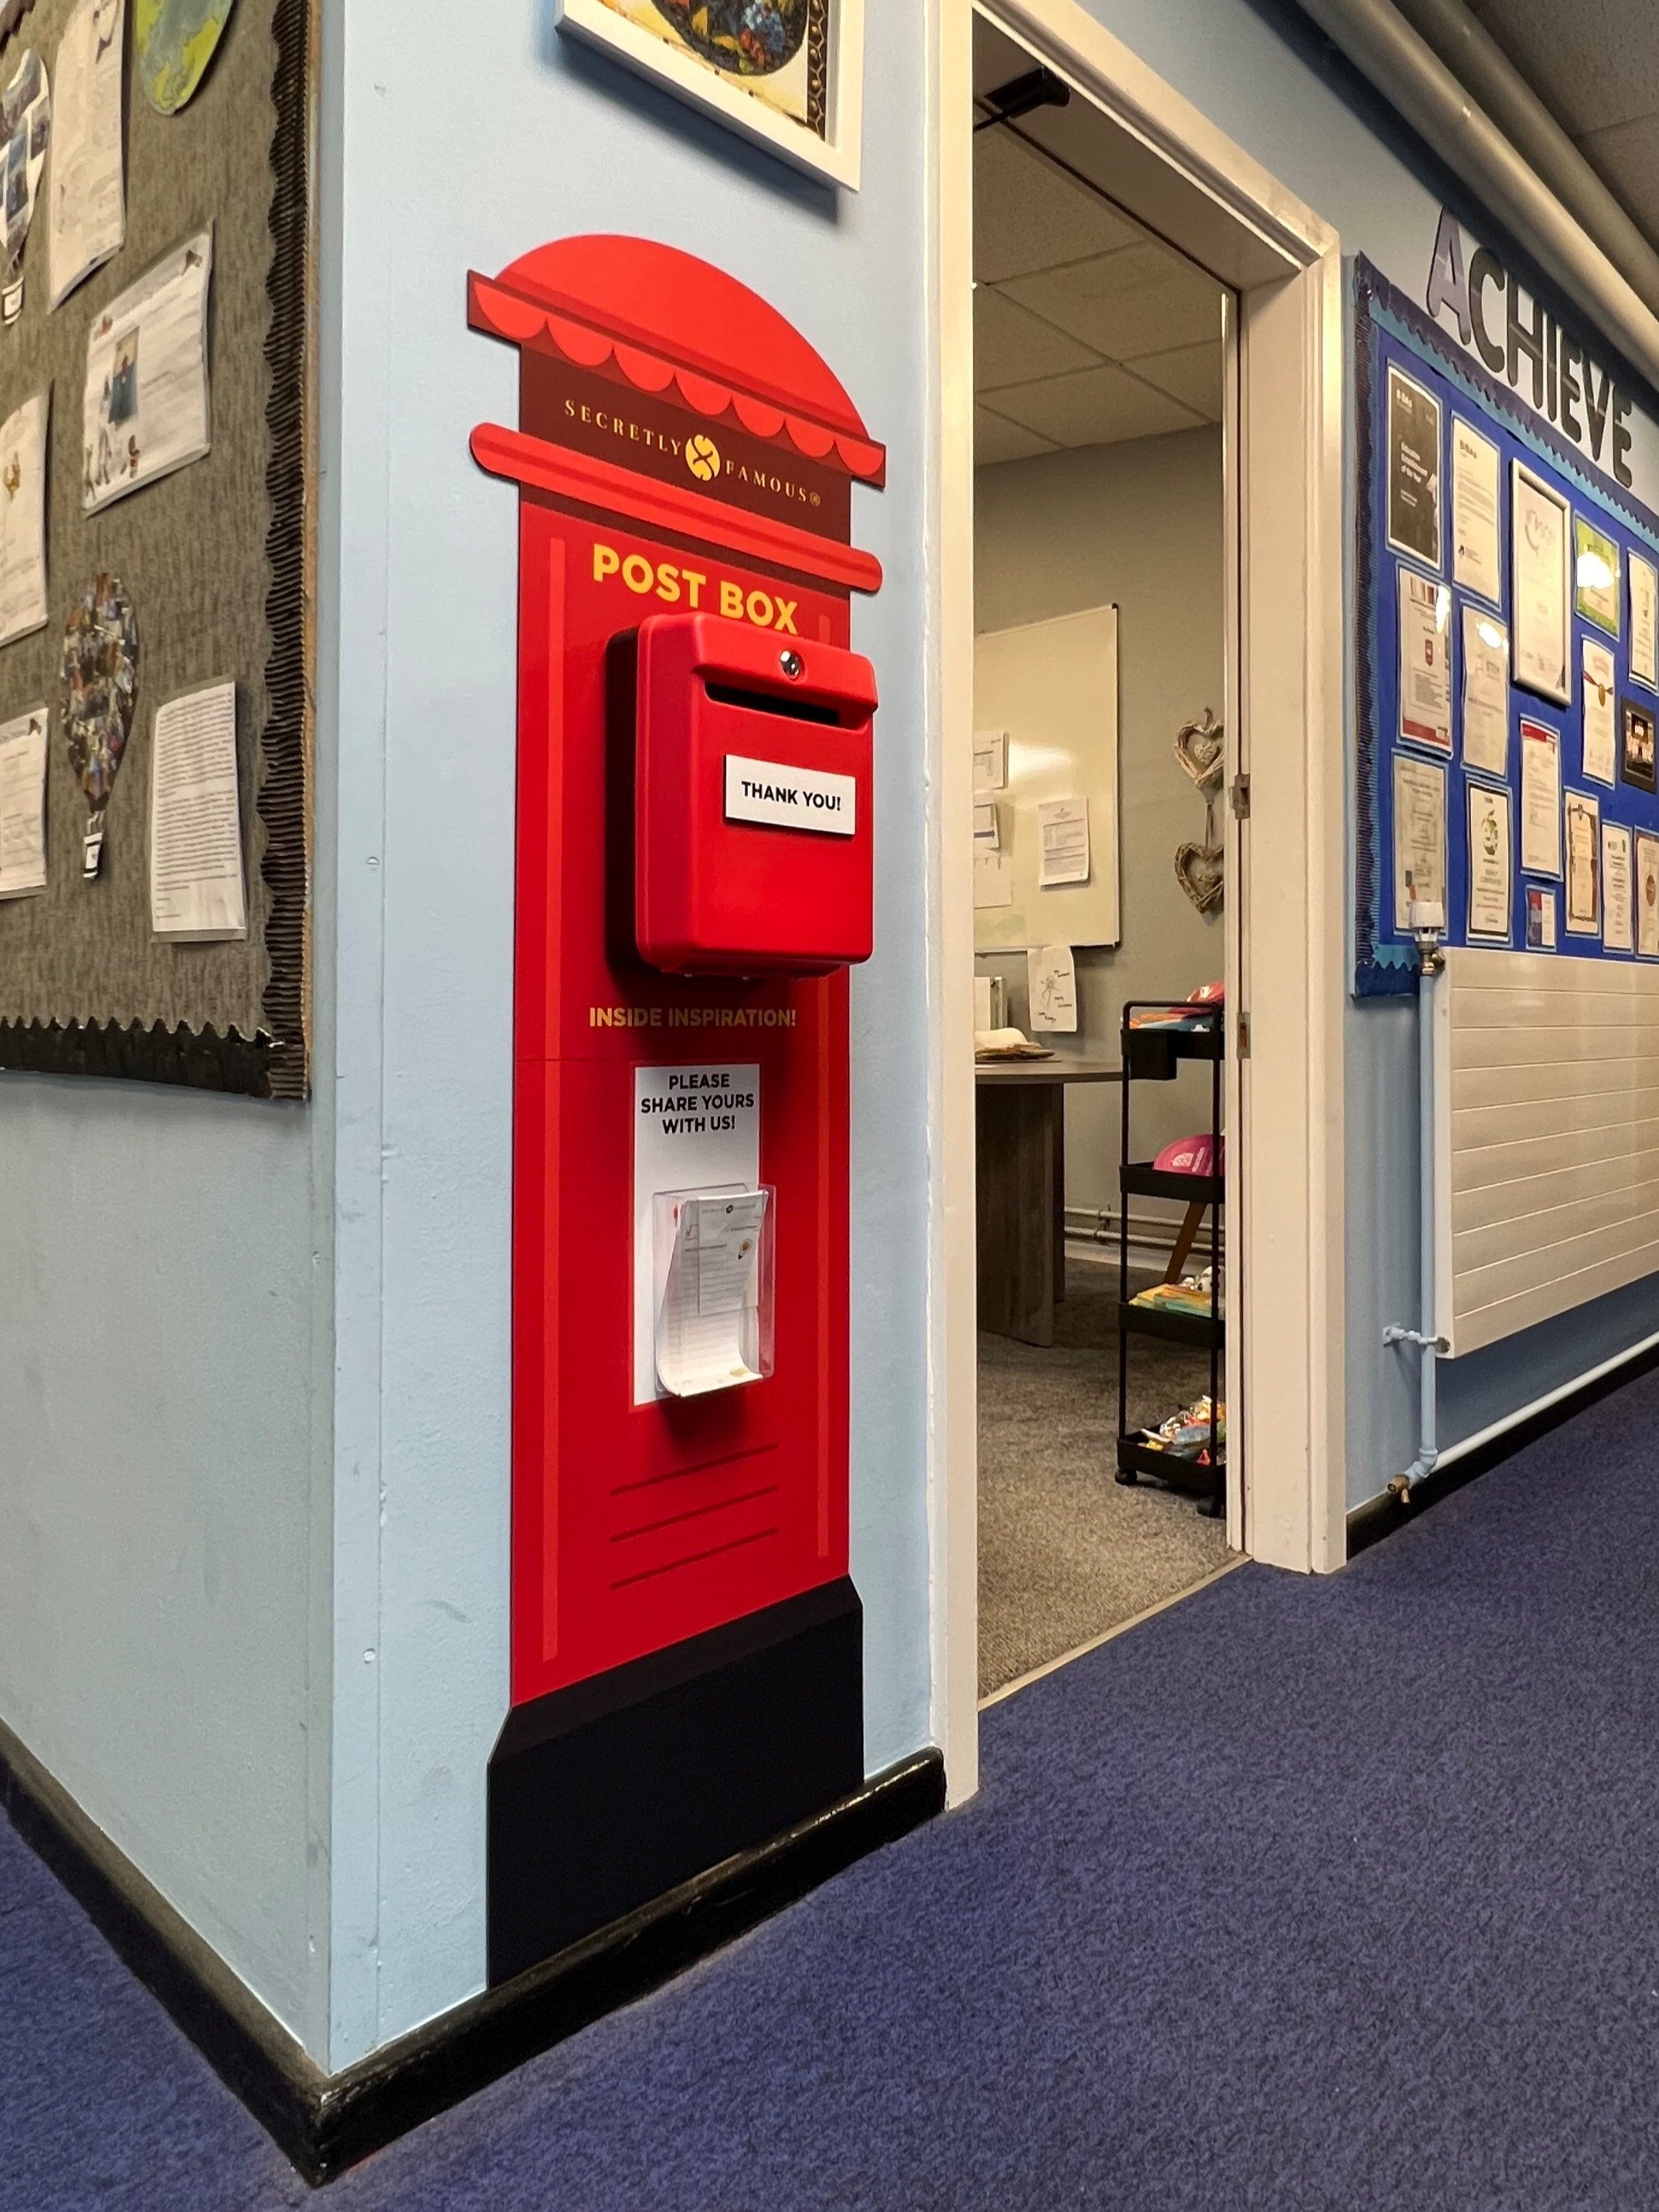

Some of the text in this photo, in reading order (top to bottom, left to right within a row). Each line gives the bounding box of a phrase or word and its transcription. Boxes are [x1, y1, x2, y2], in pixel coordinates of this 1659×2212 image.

[1426, 206, 1632, 488] ACHIEVE
[564, 399, 681, 456] SECRETLY
[593, 543, 798, 635] POST BOX
[741, 781, 840, 811] THANK YOU!
[589, 1007, 797, 1027] INSIDE INSPIRATION!
[668, 1073, 730, 1090] PLEASE
[641, 1094, 754, 1113] SHARE YOURS
[662, 1115, 735, 1134] WITH US!
